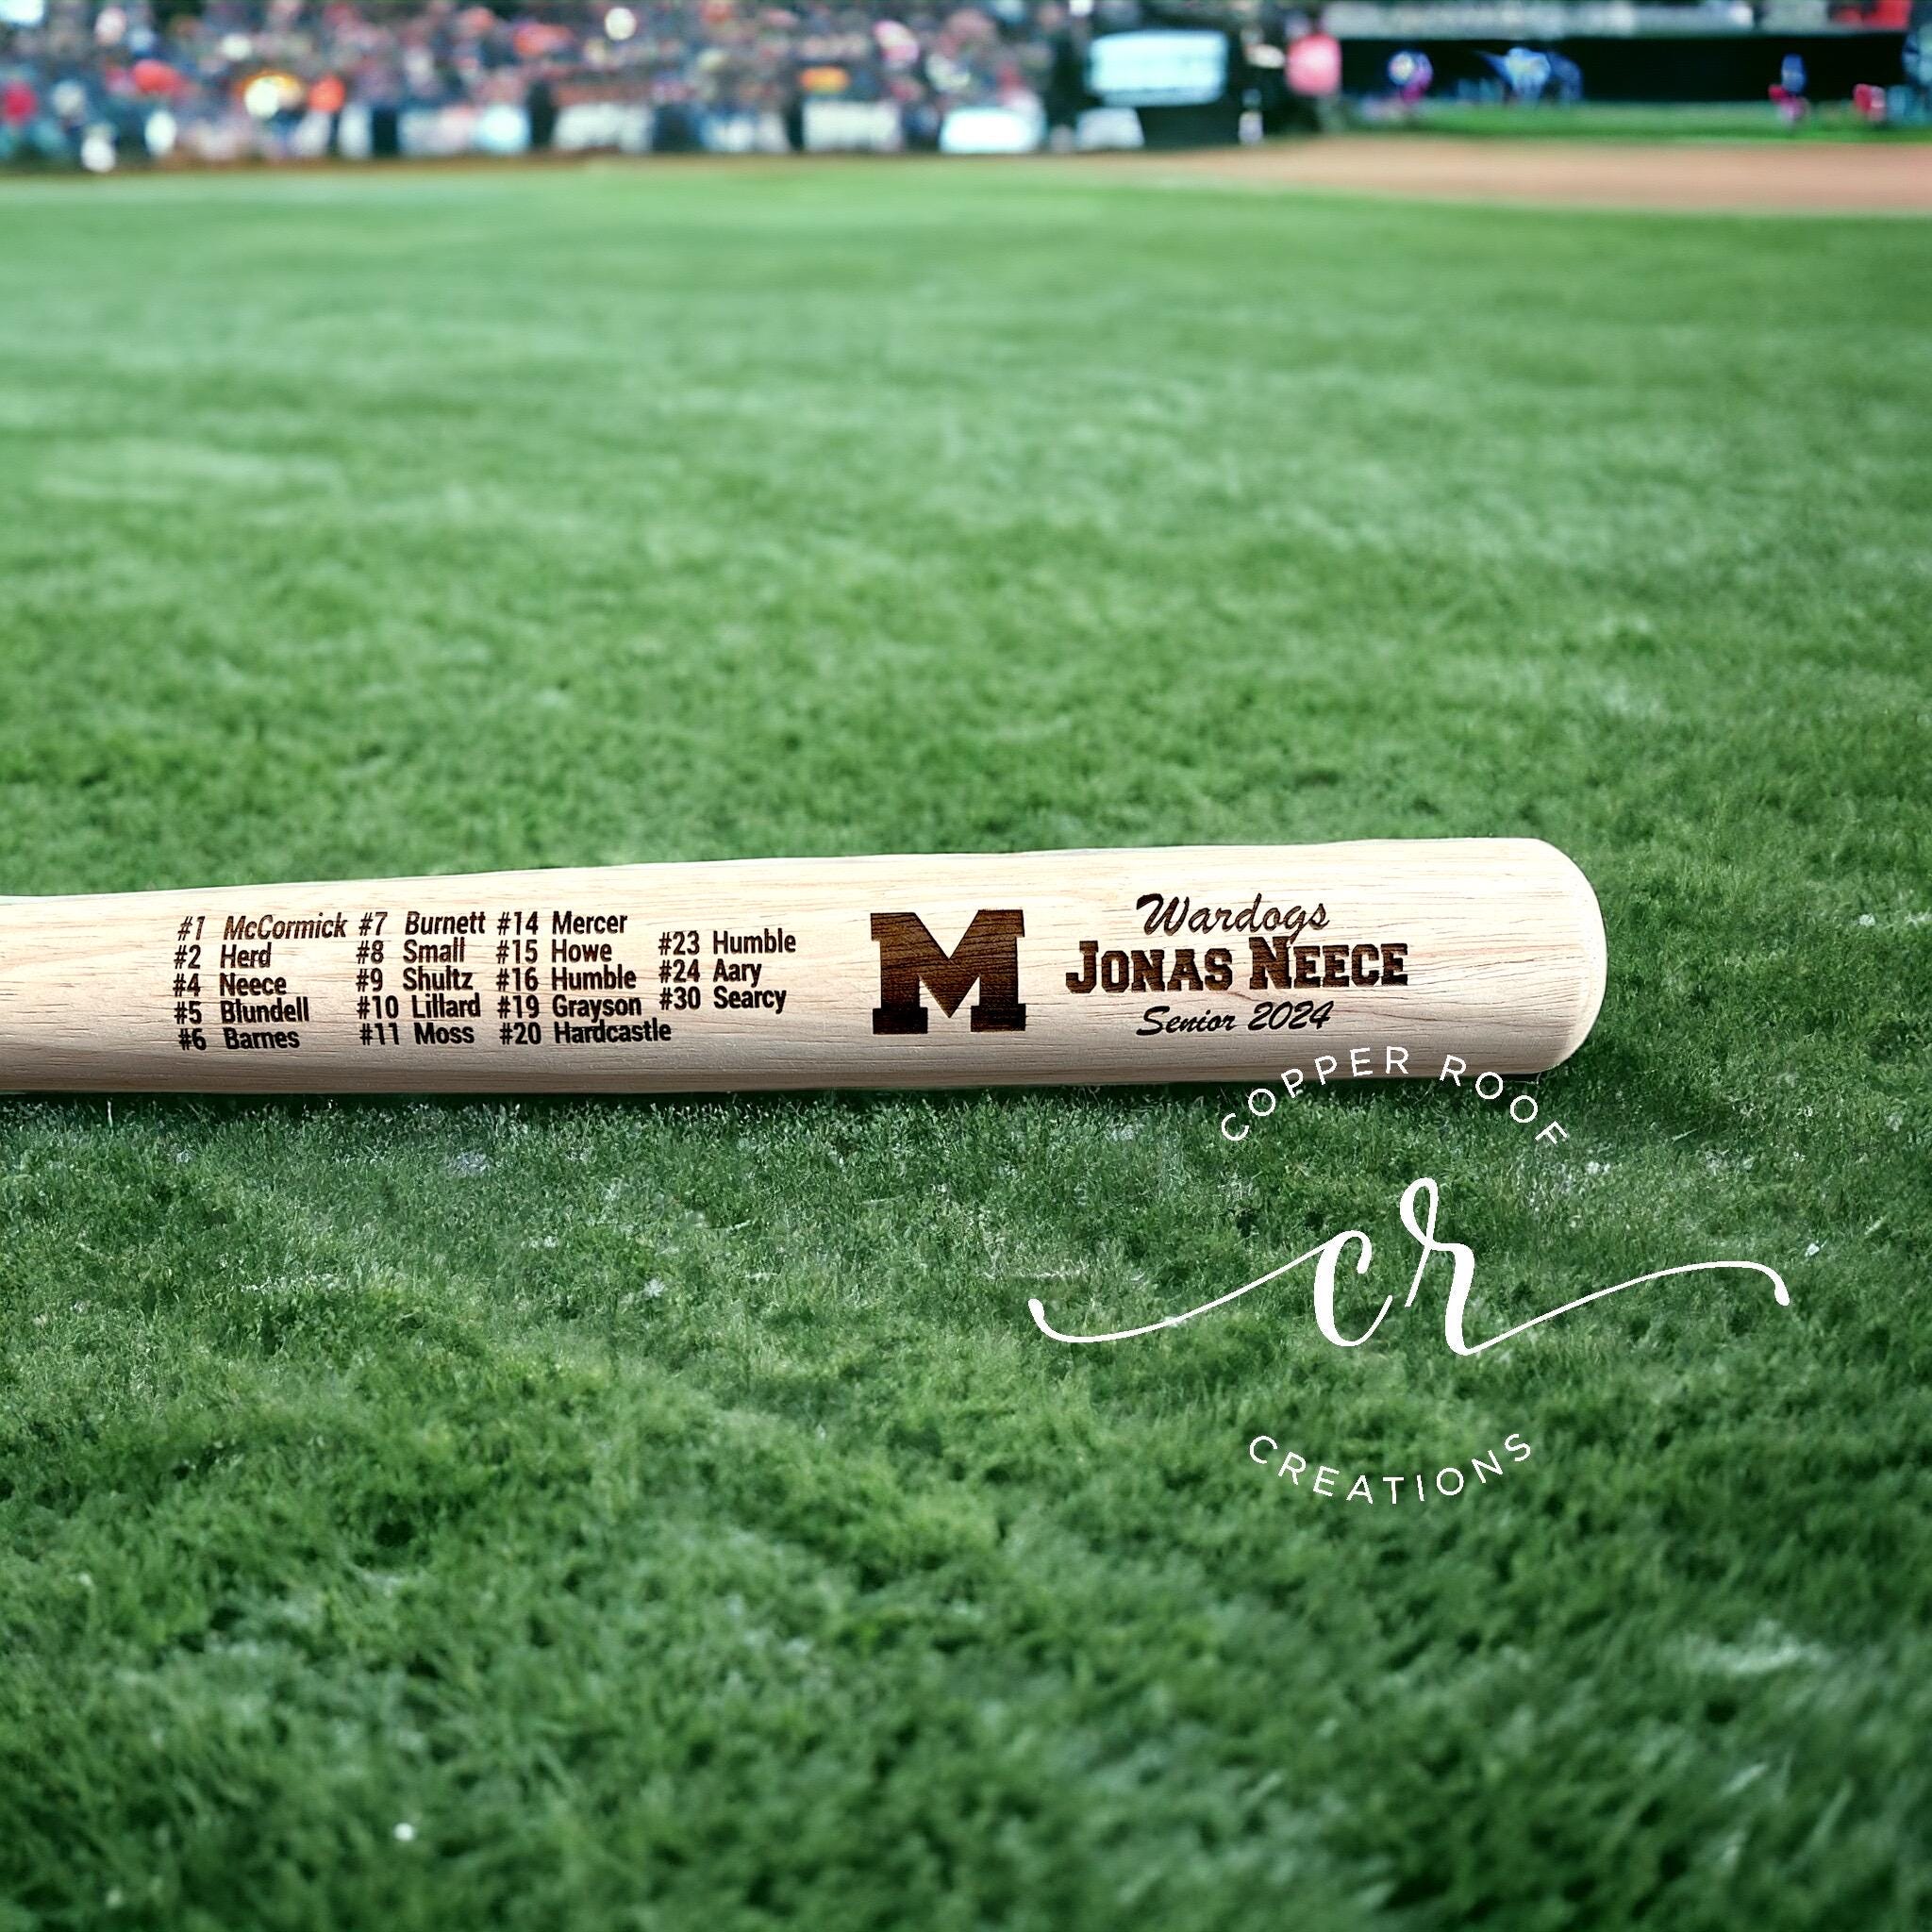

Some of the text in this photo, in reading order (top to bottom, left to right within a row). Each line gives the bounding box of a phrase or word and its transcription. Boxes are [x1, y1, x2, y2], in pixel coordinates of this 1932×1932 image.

[177, 912, 348, 941] #1 McCormick
[358, 910, 486, 936] #7 Burnett
[496, 911, 627, 936] #14 Mercer
[1136, 892, 1330, 944] Wardogs
[174, 941, 272, 970] #2 Herd
[356, 937, 465, 965] #8 Small
[495, 939, 612, 964] #15 Howe
[658, 927, 796, 956] #23 Humble
[356, 965, 474, 992] #9 Shultz
[495, 964, 637, 991] #16 Humble
[658, 958, 762, 988] #24 Aary
[871, 908, 1027, 1035] M
[1065, 936, 1408, 994] JONAS NEECE
[173, 972, 287, 997] #4 Neece
[174, 996, 309, 1024] #5 Blundell
[357, 992, 481, 1020] #10 Lillard
[497, 993, 641, 1023] #19 Grayson
[658, 985, 787, 1014] #30 Searcy
[499, 1018, 672, 1045] #20 Hardcastle
[1136, 1000, 1334, 1036] Senior 2024
[177, 1026, 300, 1051] #6 Barnes
[359, 1022, 475, 1046] #11 Moss
